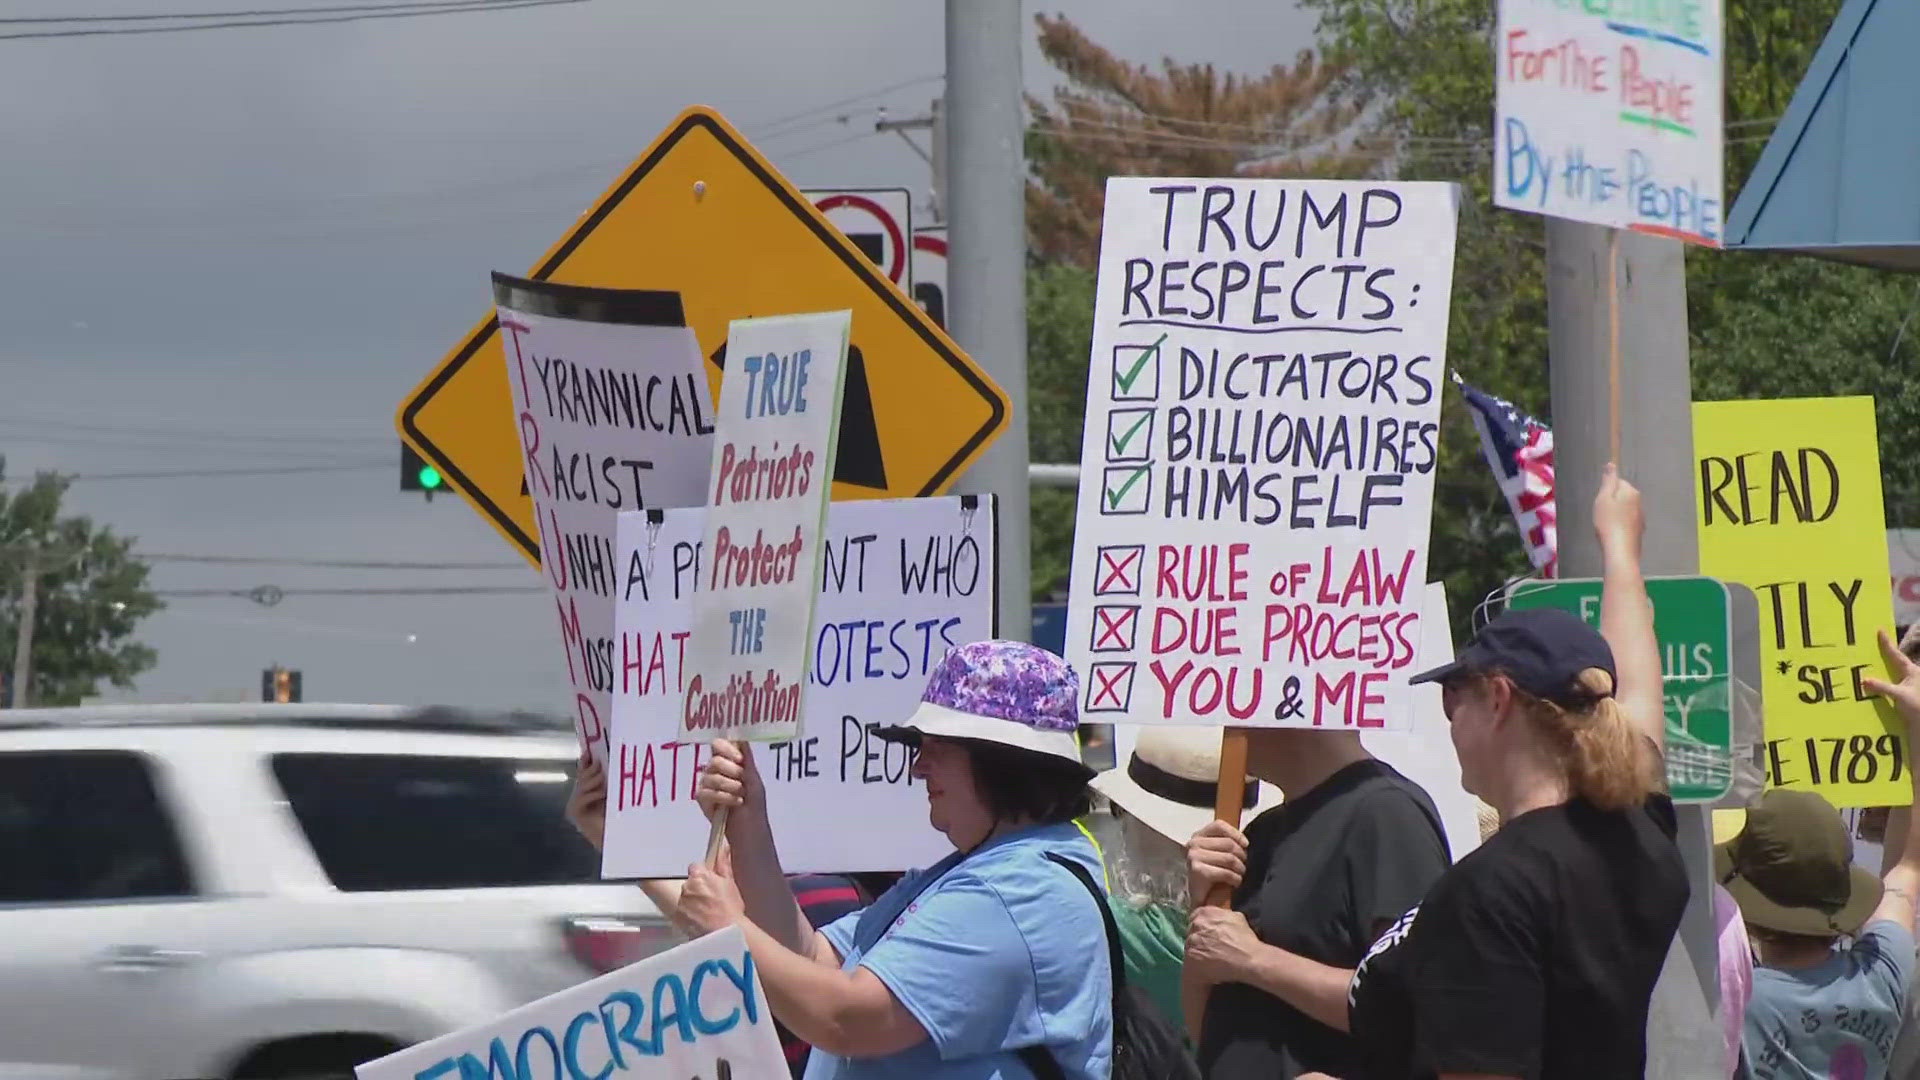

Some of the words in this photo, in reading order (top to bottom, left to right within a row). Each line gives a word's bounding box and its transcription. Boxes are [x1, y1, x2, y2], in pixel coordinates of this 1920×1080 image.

[1505, 117, 1552, 207] By
[1149, 185, 1402, 259] TRUMP
[744, 349, 811, 420] TRUE
[1179, 346, 1433, 406] DICTATORS
[1167, 405, 1438, 475] BILLIONAIRES
[715, 441, 814, 507] Patriots
[1164, 466, 1404, 530] HIMSELF
[1700, 447, 1840, 527] READ
[625, 549, 649, 601] A
[900, 535, 980, 598] WHO
[711, 524, 803, 591] Protect
[1156, 543, 1251, 602] RULE
[1316, 545, 1416, 608] LAW
[729, 607, 767, 656] THE
[1151, 606, 1242, 657] DUE
[1262, 602, 1419, 670] PROCESS
[685, 668, 800, 732] Constitution
[1149, 660, 1263, 721] YOU
[1274, 675, 1306, 721] &
[1312, 670, 1389, 728] ME
[769, 737, 820, 783] THE
[1804, 734, 1903, 786] 1789
